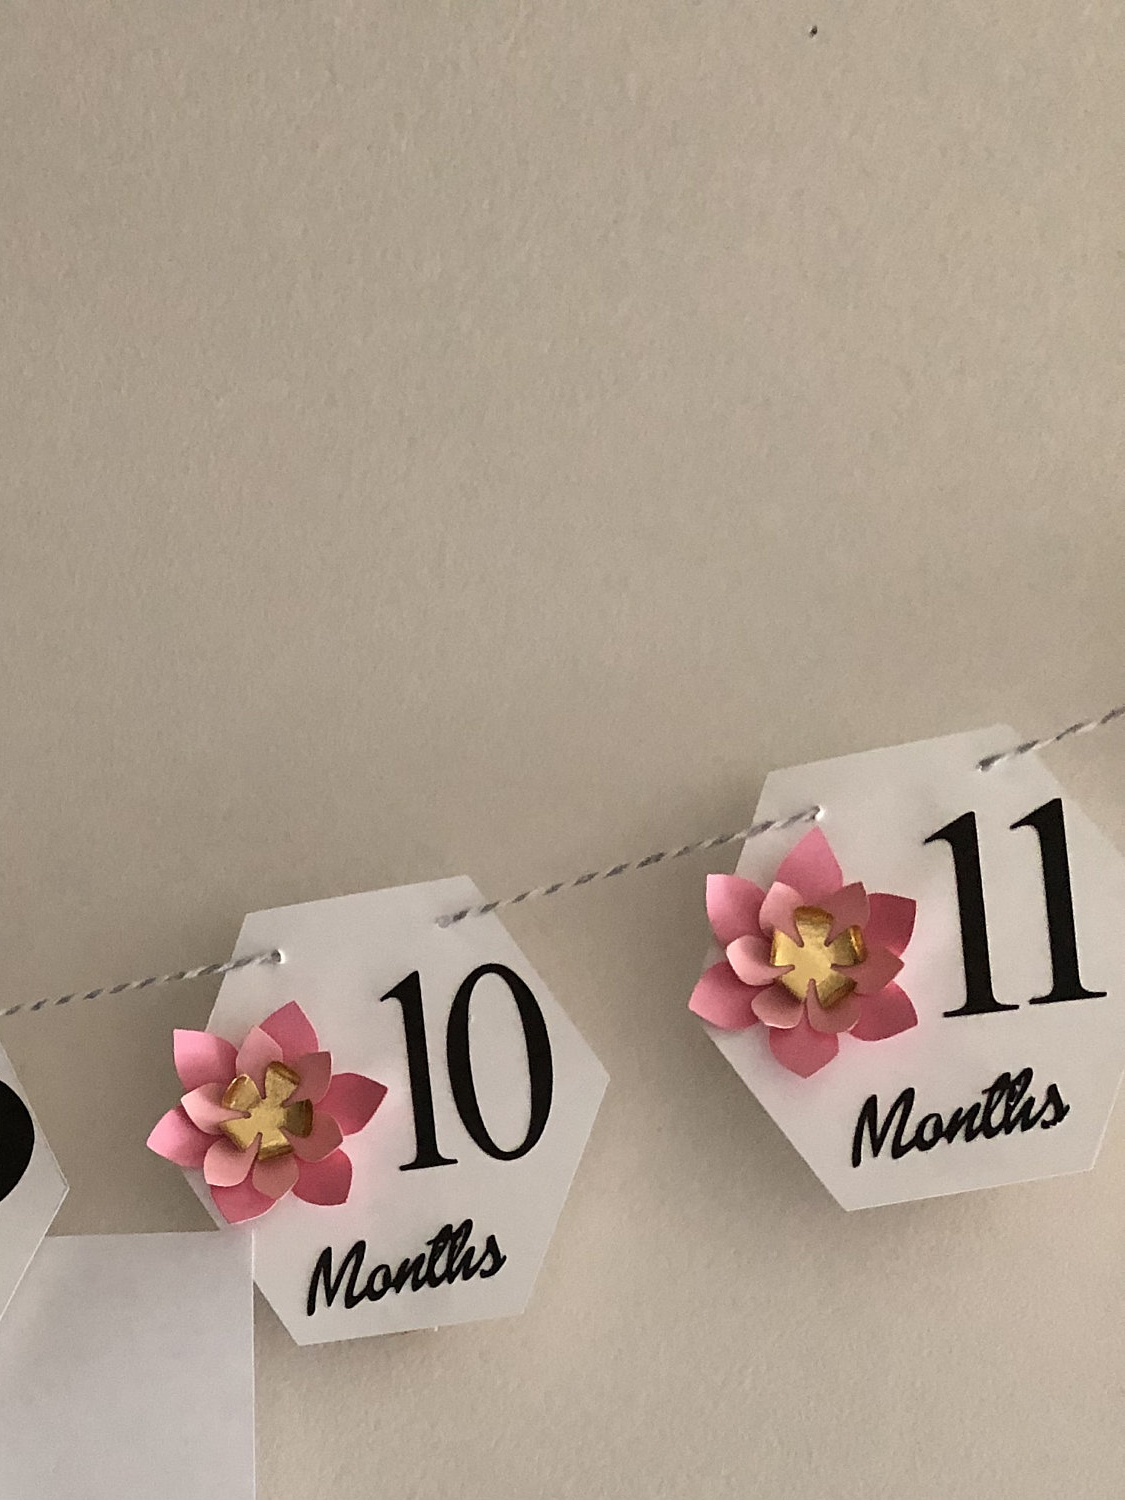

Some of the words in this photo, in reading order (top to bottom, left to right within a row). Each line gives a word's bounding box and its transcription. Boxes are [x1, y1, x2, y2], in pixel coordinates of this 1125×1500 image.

[923, 797, 1108, 1018] 11
[380, 962, 554, 1172] 10
[851, 1067, 1071, 1169] Months
[306, 1218, 507, 1317] Months
